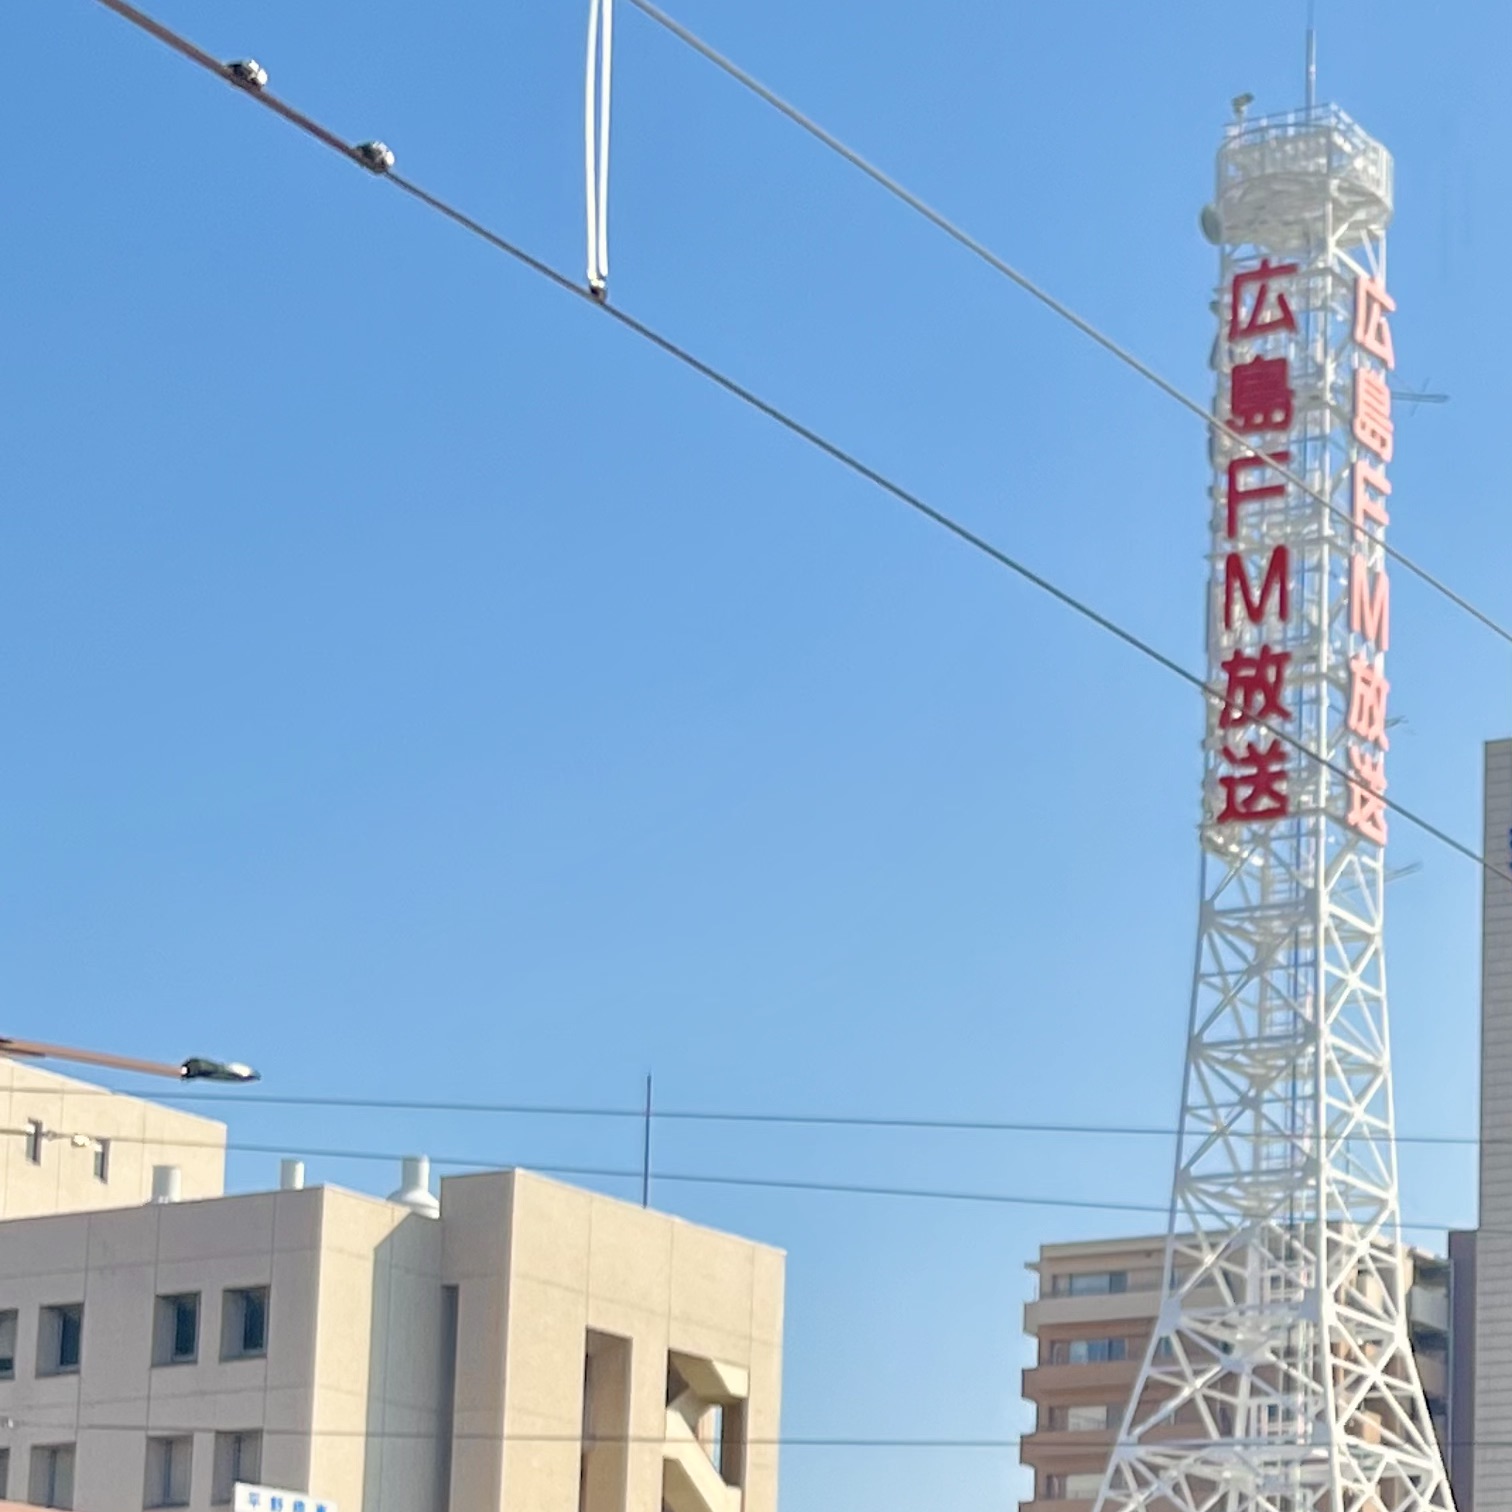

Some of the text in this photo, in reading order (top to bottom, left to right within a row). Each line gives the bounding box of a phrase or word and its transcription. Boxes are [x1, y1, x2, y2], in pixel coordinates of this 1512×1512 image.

[1218, 259, 1297, 824] 広島FM放送
[1348, 274, 1396, 846] 広島FM放送
